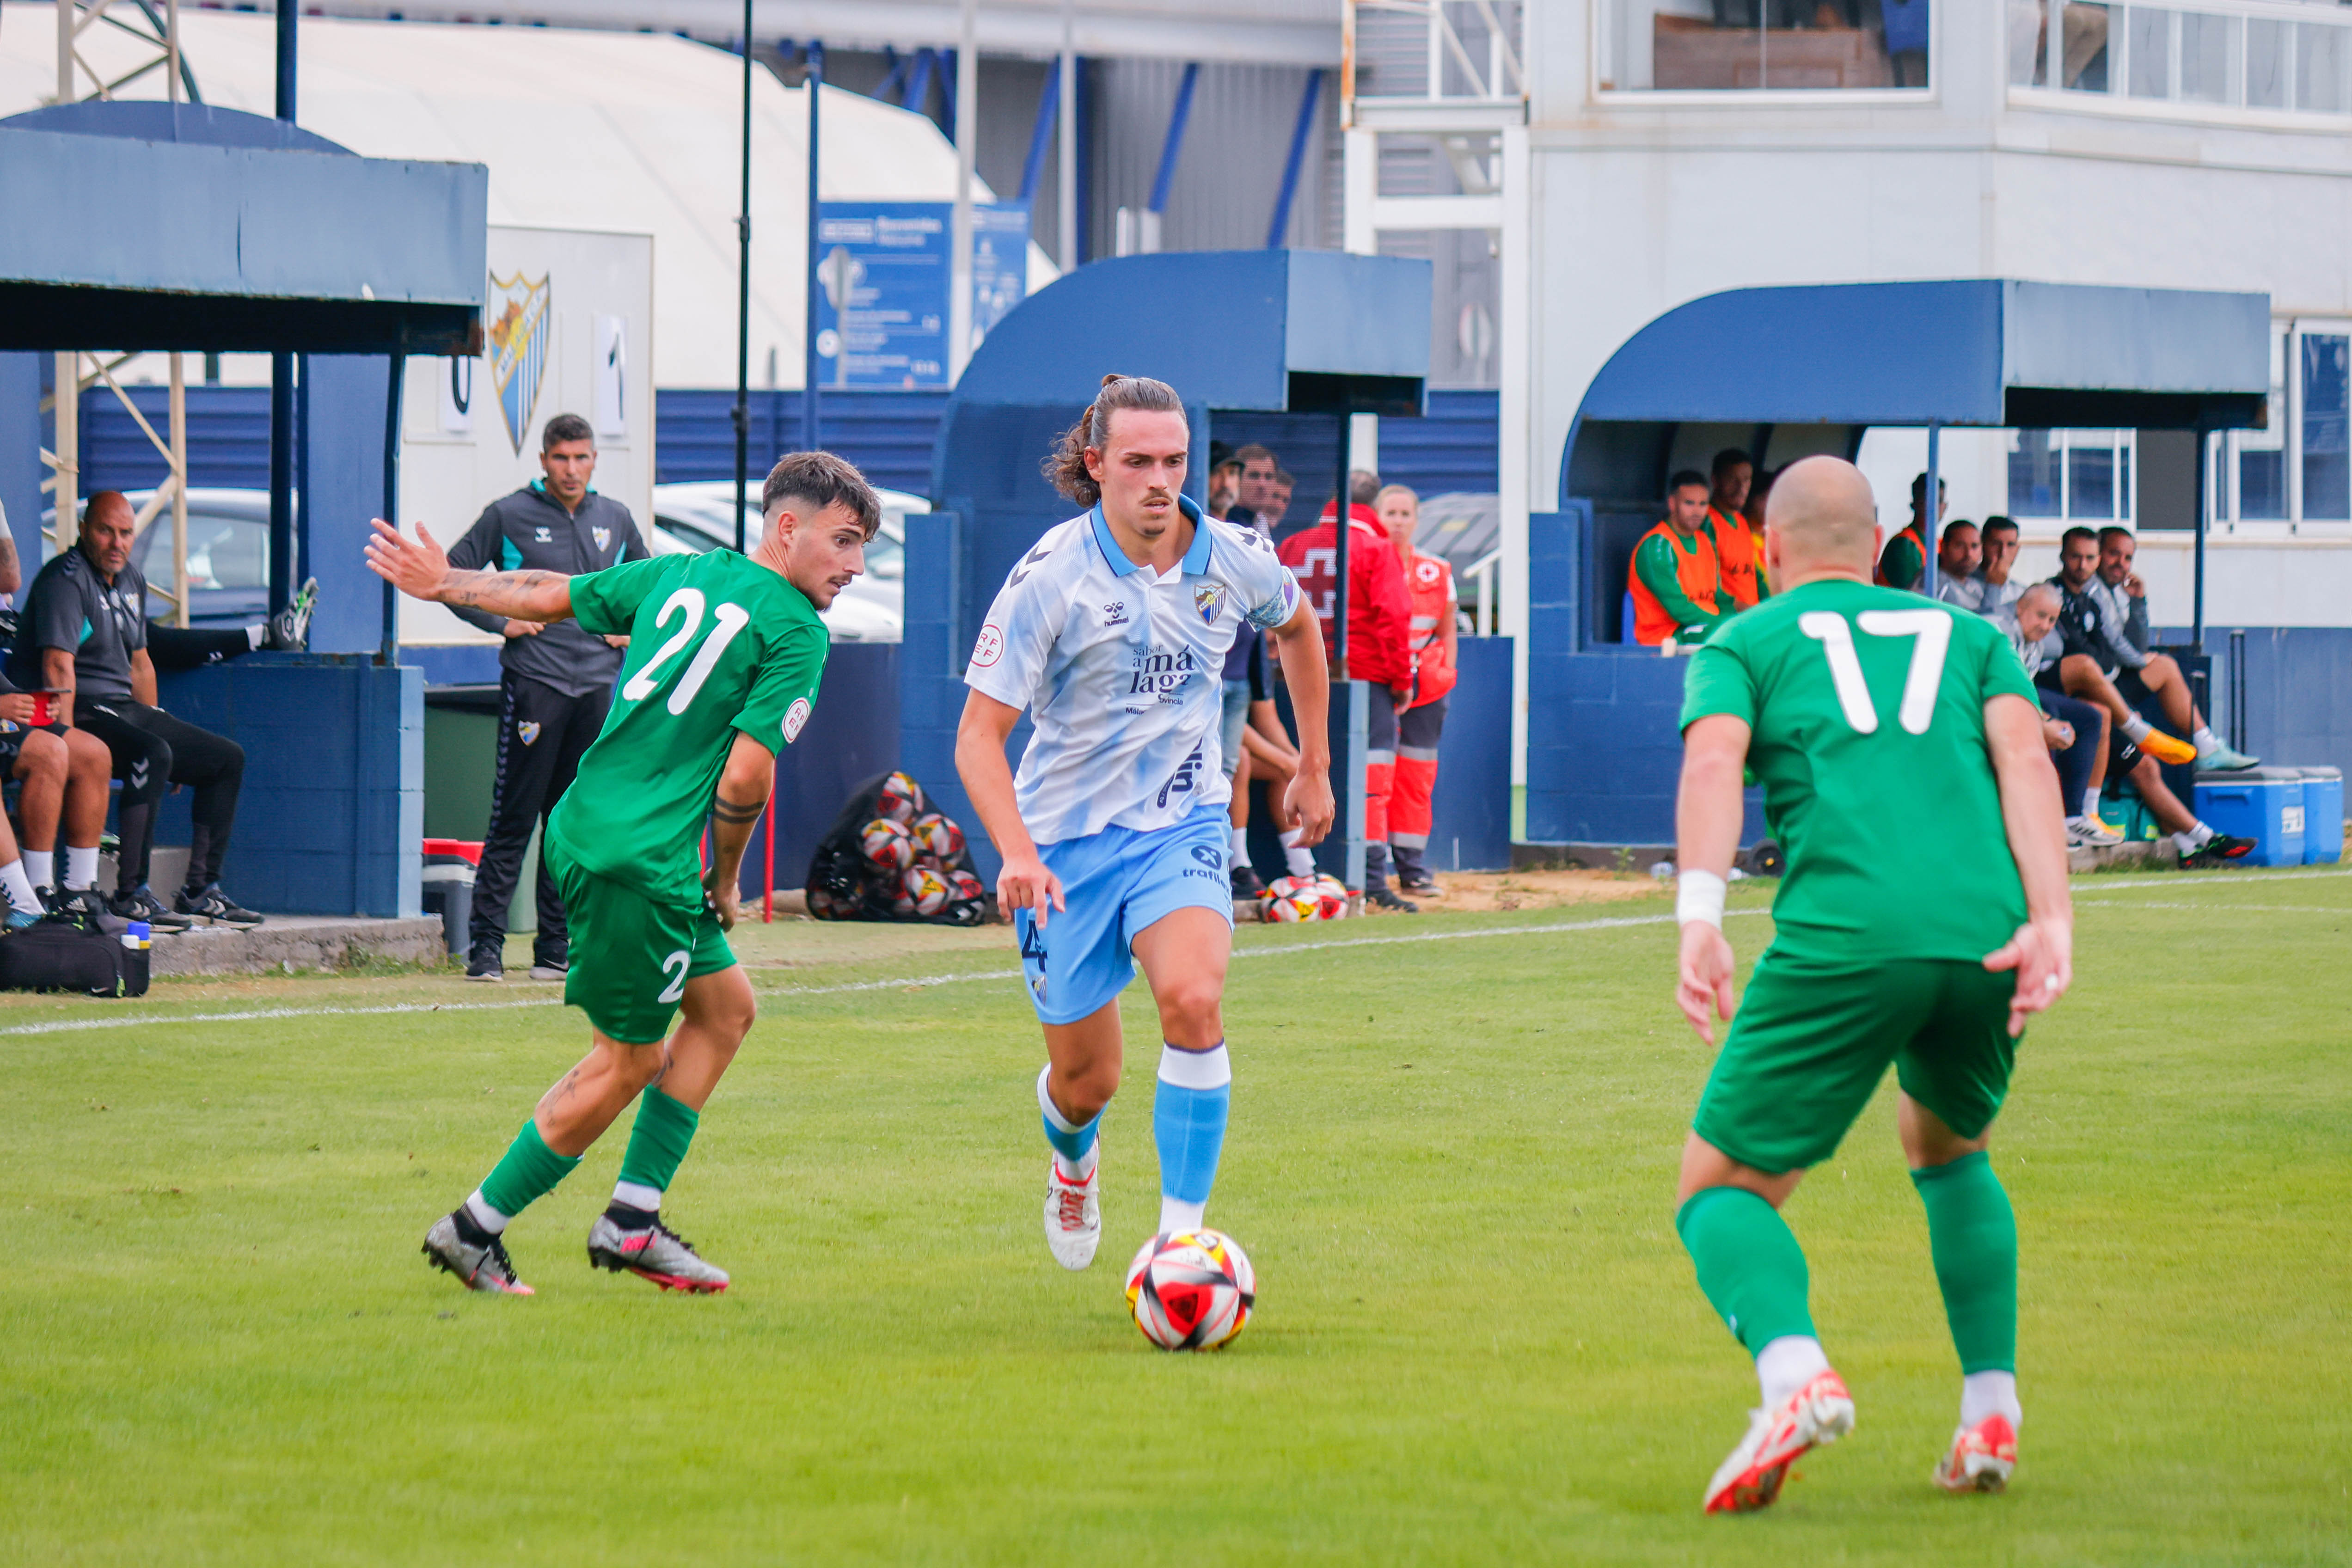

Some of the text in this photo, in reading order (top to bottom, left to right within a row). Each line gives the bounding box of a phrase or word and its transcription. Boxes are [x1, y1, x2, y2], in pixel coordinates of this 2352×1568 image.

[623, 588, 749, 715] 21
[1104, 616, 1129, 627] hummel
[1133, 645, 1163, 656] sabor
[1798, 609, 1953, 735] 17
